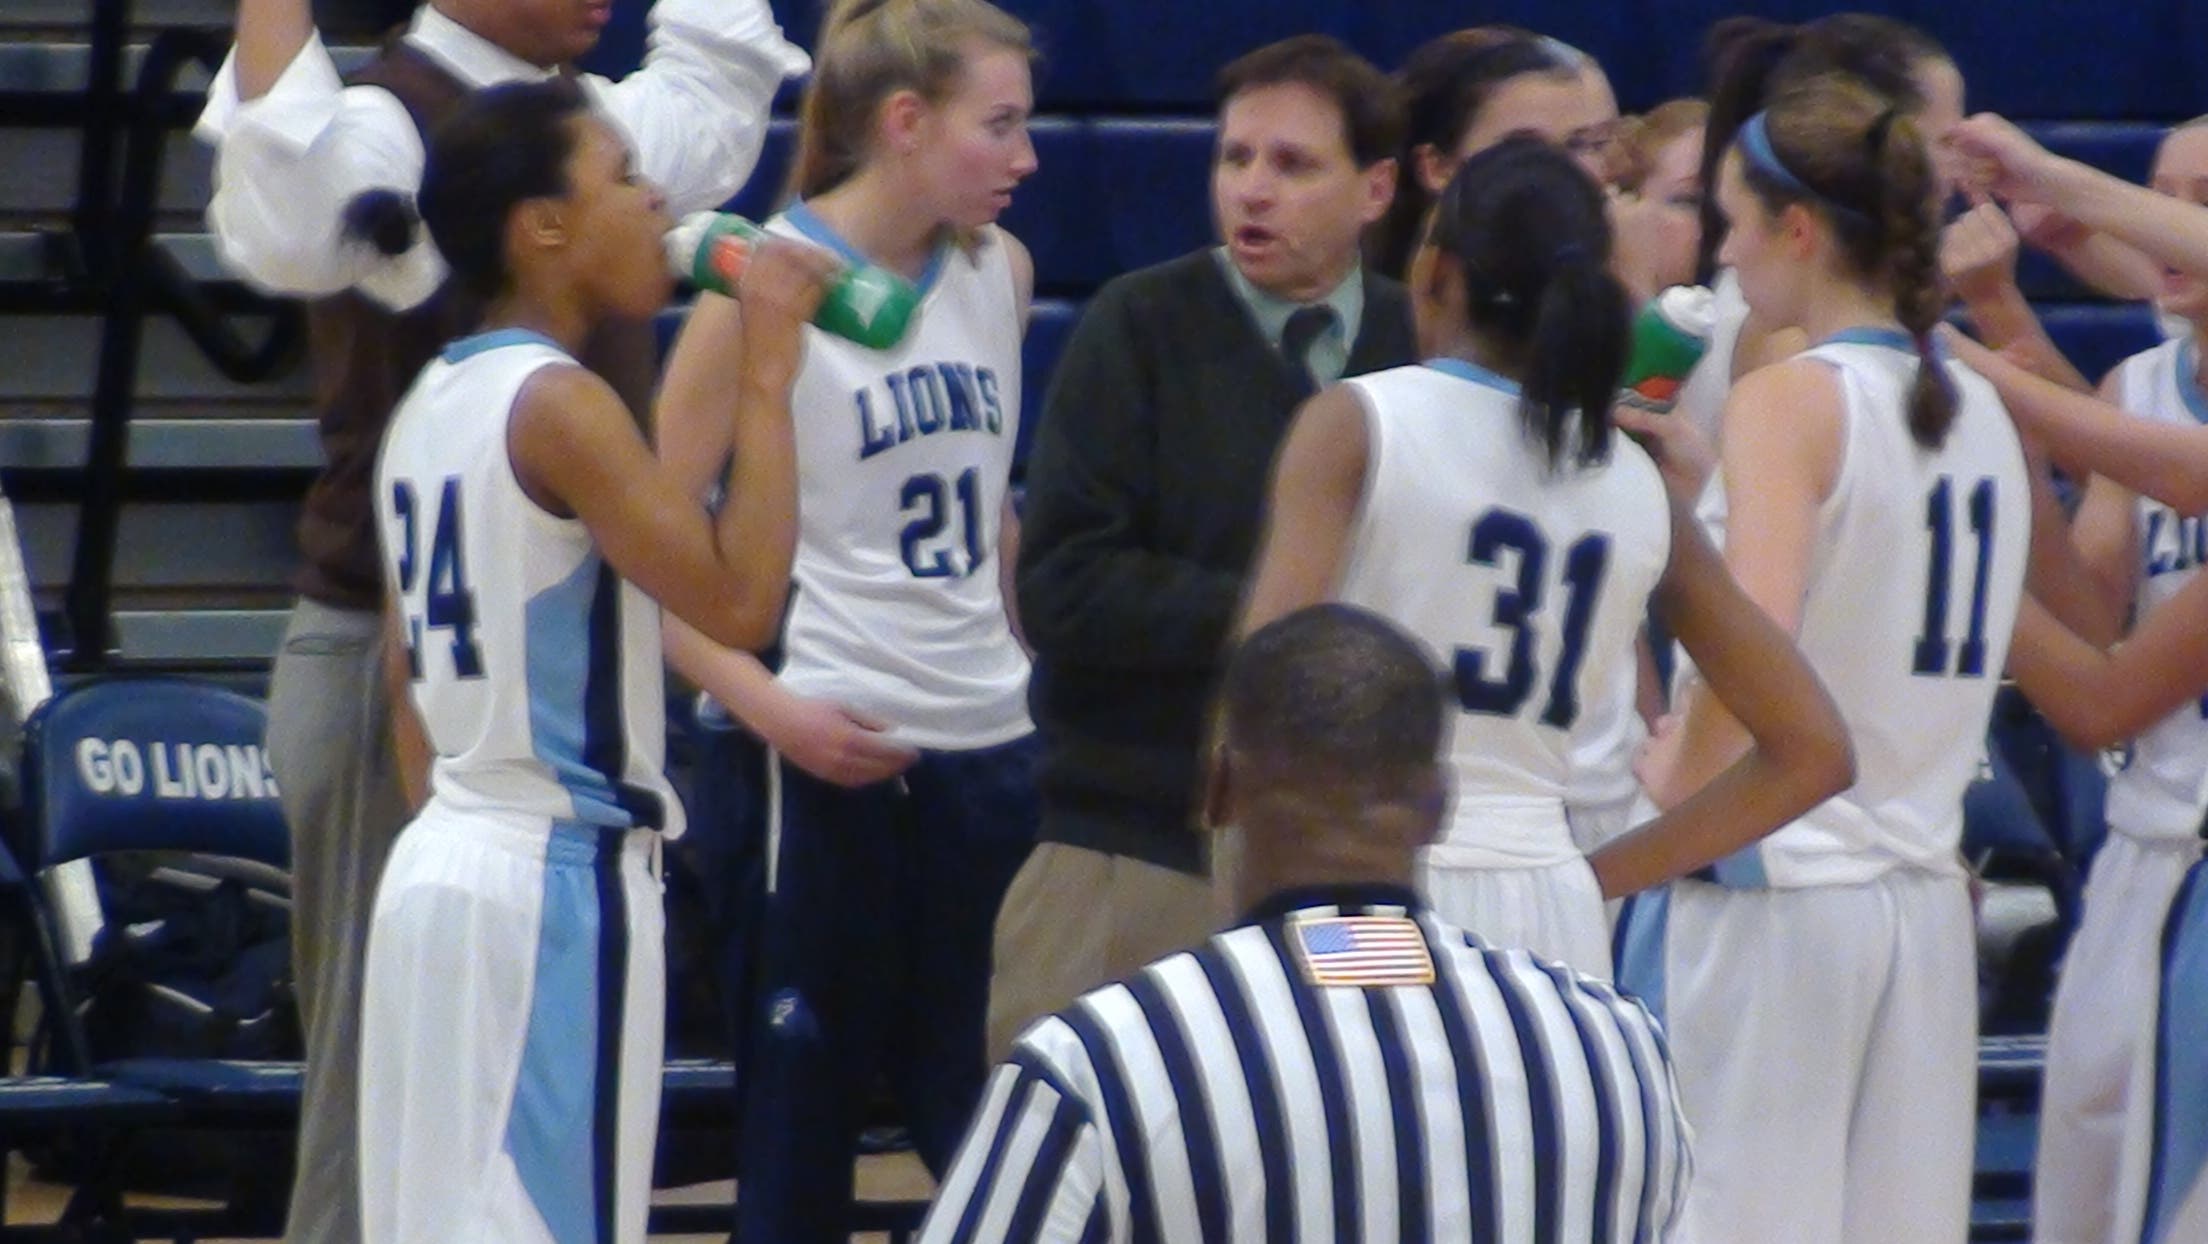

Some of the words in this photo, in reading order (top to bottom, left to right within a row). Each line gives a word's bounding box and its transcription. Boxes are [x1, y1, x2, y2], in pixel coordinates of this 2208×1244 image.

[855, 361, 1002, 459] LIONS
[900, 466, 984, 578] 21
[2147, 508, 2208, 576] LI
[1452, 504, 1614, 732] 31
[1911, 473, 1998, 677] 11
[77, 736, 145, 796] GO
